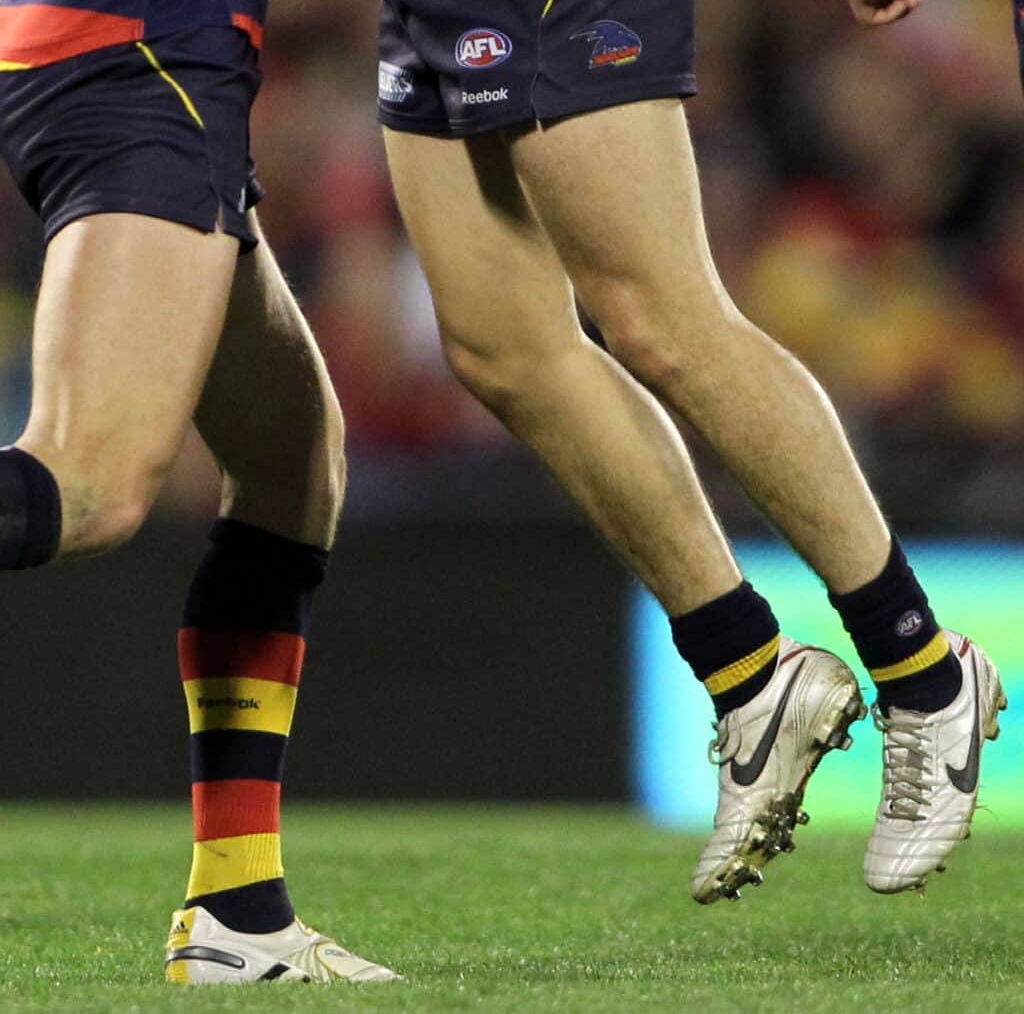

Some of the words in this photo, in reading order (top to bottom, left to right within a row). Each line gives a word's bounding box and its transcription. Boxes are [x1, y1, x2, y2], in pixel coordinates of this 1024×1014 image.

[460, 37, 507, 61] AFL
[461, 87, 509, 104] Reebok
[897, 614, 922, 634] AFL
